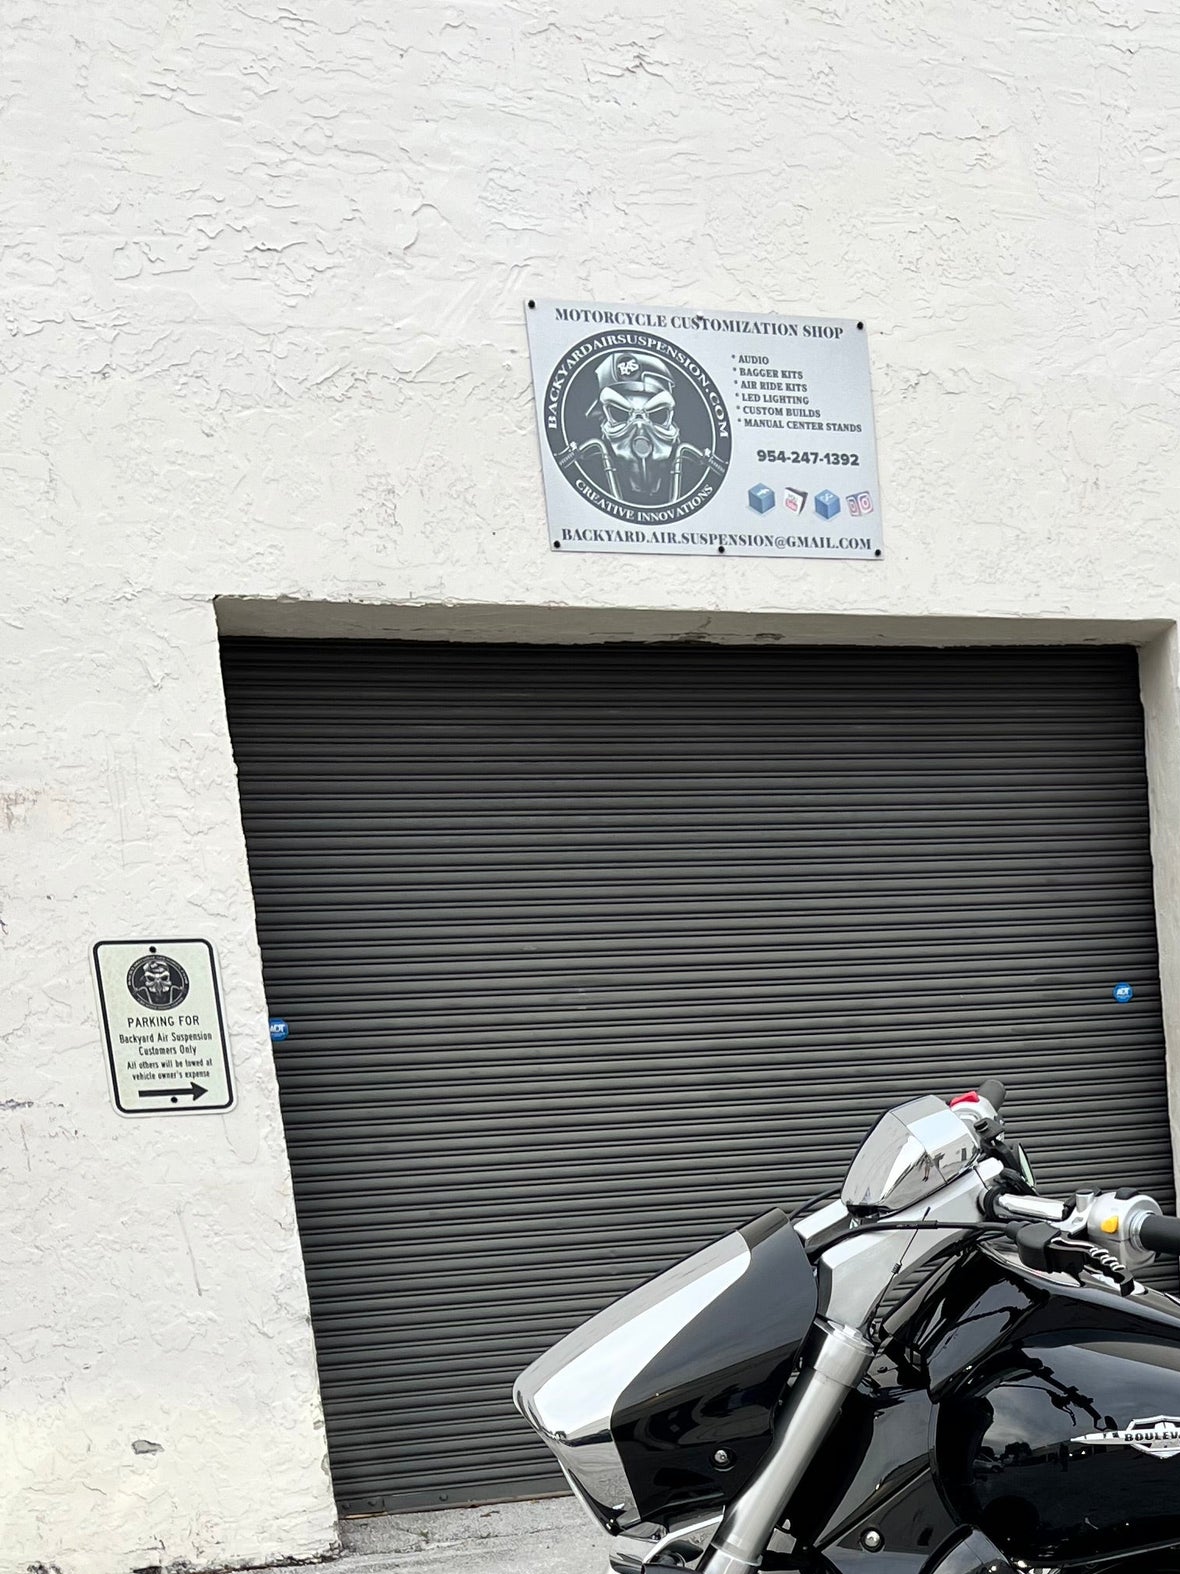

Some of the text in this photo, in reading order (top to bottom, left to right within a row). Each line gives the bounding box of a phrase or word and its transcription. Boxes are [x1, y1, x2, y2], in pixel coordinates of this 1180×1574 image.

[554, 307, 844, 340] MOTORCYCLE CUSTOMIZATION SHOP
[738, 354, 769, 365] AUDIO
[739, 367, 804, 380] BAGGER KITS
[548, 333, 729, 439] BACKYARDAIRSUSPENSION.COM
[740, 380, 808, 393] AIR RIDE KITS
[741, 393, 810, 406] LED LIGHTING
[742, 405, 821, 418] CUSTOM BUILDS
[743, 418, 862, 433] MANUAL CENTER STANDS
[756, 449, 860, 467] 954-247-1392
[574, 478, 714, 523] CREATIVE INNOVATIONS
[561, 528, 872, 550] BACKYARD.AIR.SUSPENSION@GMAIL.COM
[127, 1015, 200, 1028] PARKING FOR
[119, 1031, 213, 1045] Backyard Air Suspension
[138, 1044, 197, 1056] Customers Only
[127, 1058, 213, 1070] All others will be towed at
[132, 1070, 210, 1080] vehicle owner's expense
